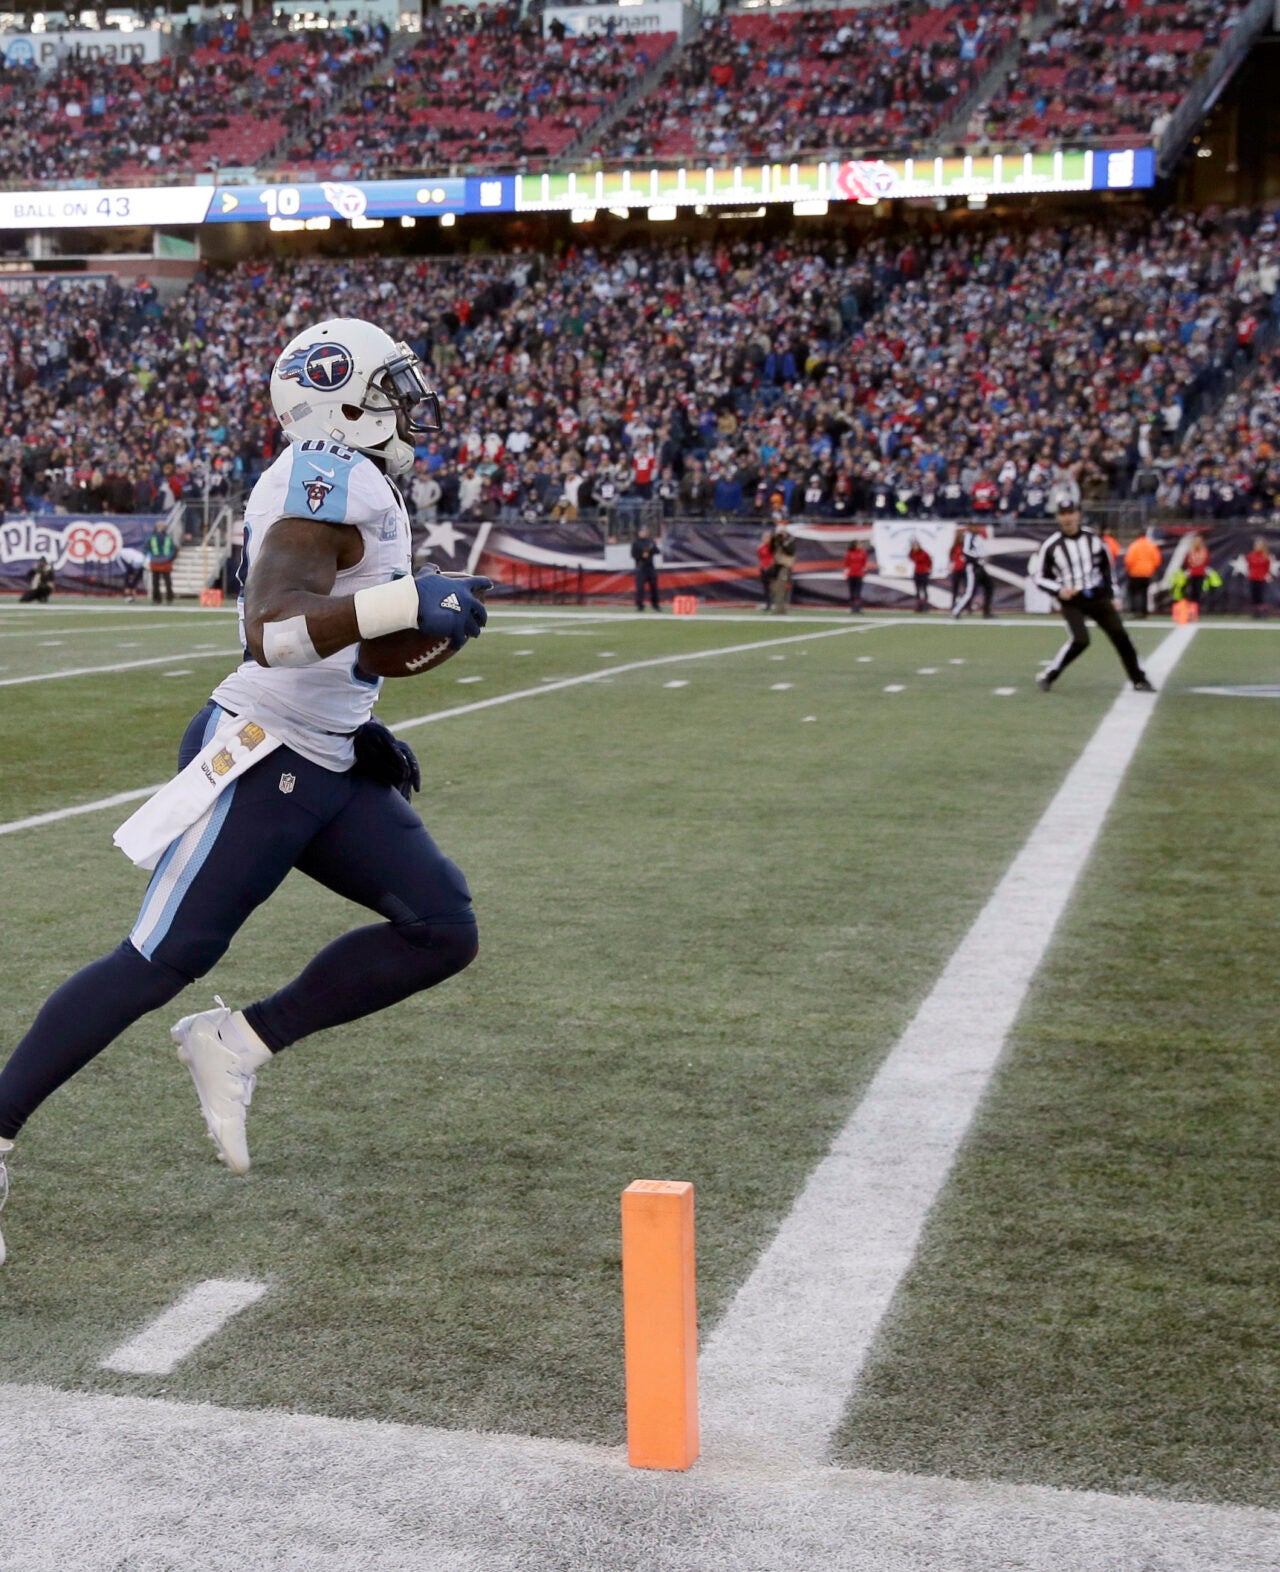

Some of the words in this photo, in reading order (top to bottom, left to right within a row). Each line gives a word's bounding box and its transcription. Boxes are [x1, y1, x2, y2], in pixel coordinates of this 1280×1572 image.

[40, 40, 146, 62] Ptnam
[14, 203, 55, 218] BALL
[63, 203, 87, 216] ON
[96, 197, 131, 217] 43
[259, 188, 300, 215] 10
[201, 761, 217, 788] Wilson
